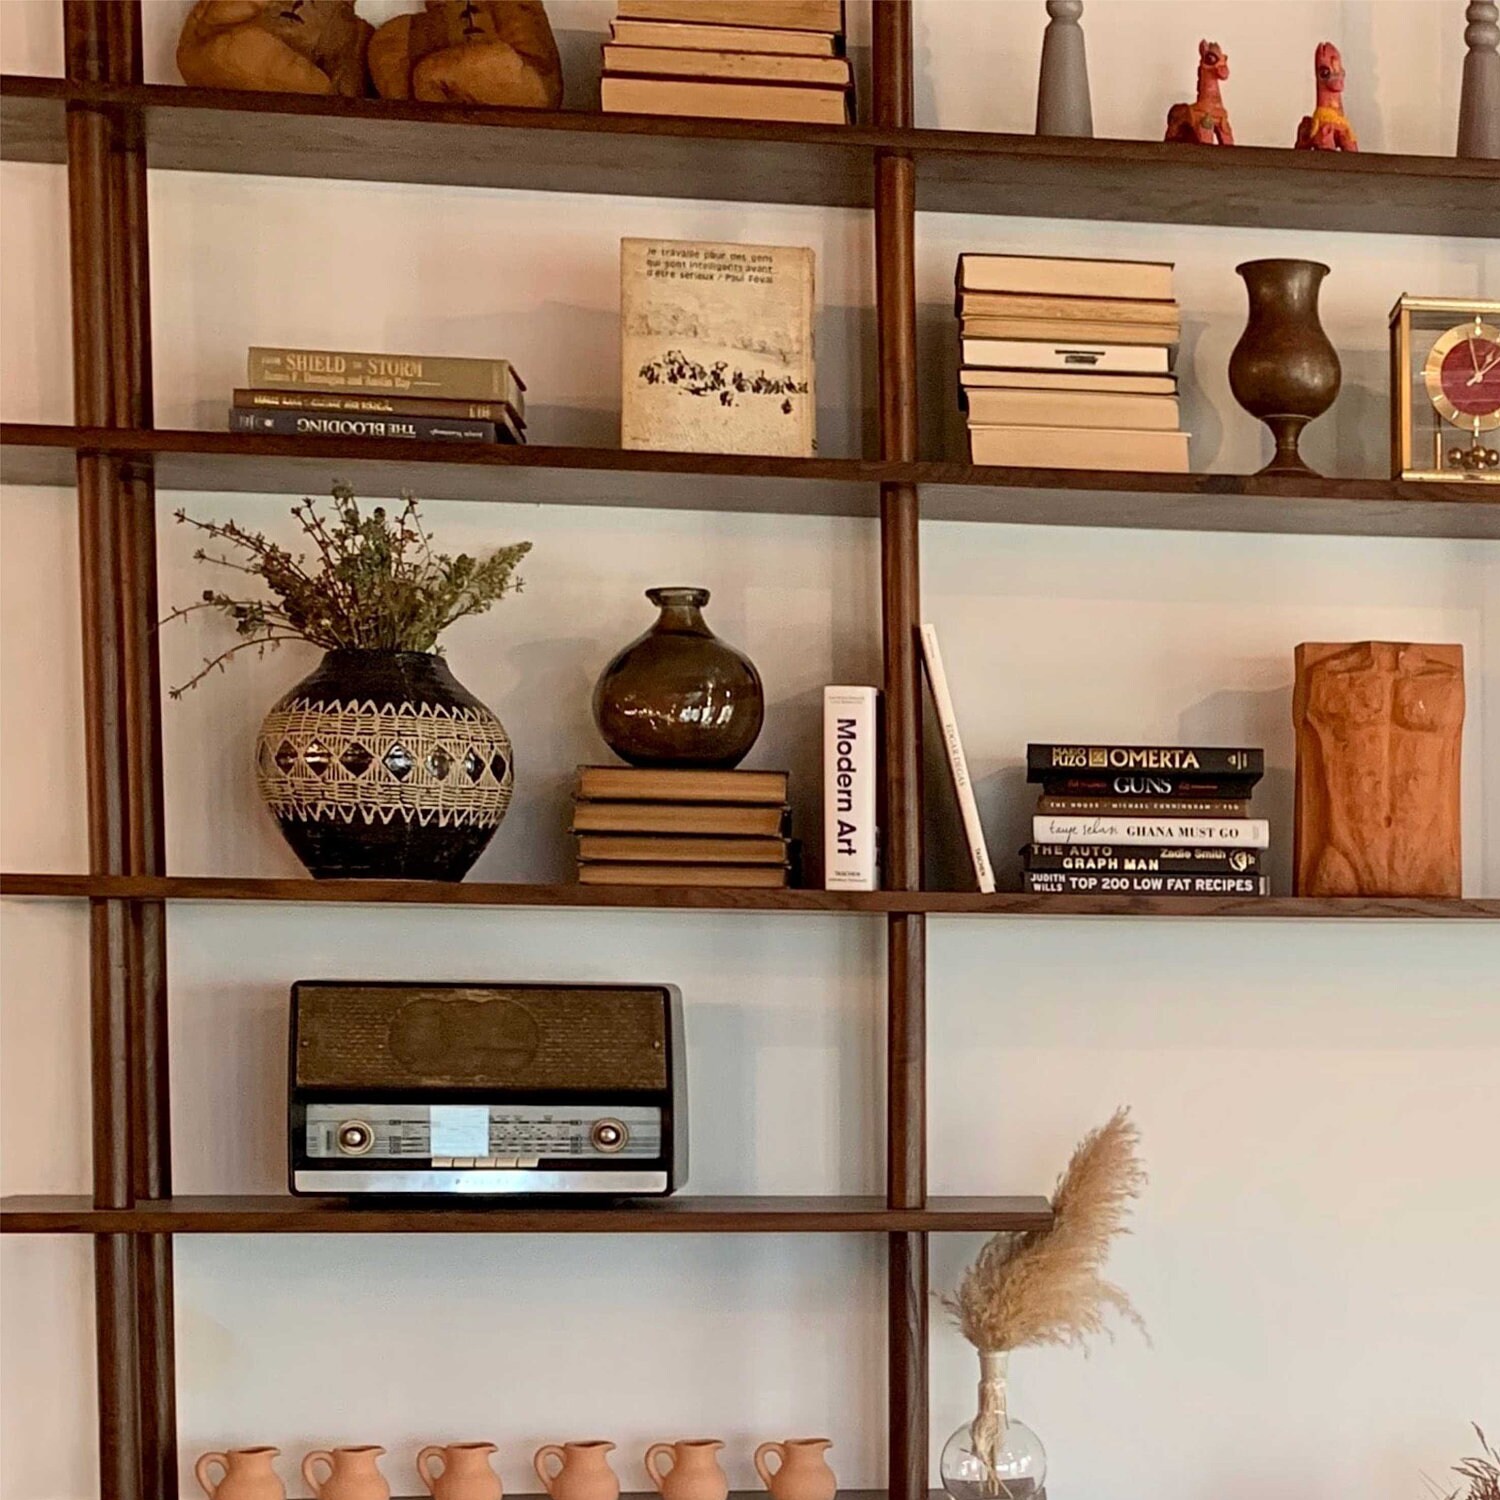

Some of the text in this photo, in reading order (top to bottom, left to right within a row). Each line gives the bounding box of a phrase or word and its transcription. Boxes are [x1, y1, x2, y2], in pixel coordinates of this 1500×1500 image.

[286, 354, 346, 373] SHIELD
[367, 357, 422, 377] STORM
[297, 417, 386, 437] BLOODING
[388, 423, 417, 438] THE
[836, 718, 857, 812] Modern
[1052, 755, 1087, 767] PUZO
[1109, 748, 1200, 769] OMERTA
[1113, 776, 1172, 794] GUNS
[836, 820, 857, 856] Art
[1127, 825, 1240, 839] GHANA MUST GO
[1031, 844, 1114, 857] THE AUTO
[1160, 848, 1227, 860] Zadie Smith
[1062, 857, 1160, 872] GRAPH MAN
[1030, 873, 1066, 883] JUDITH
[1069, 876, 1254, 892] TOP 200 LOW FAT RECIPES
[1033, 882, 1063, 893] WILLS
